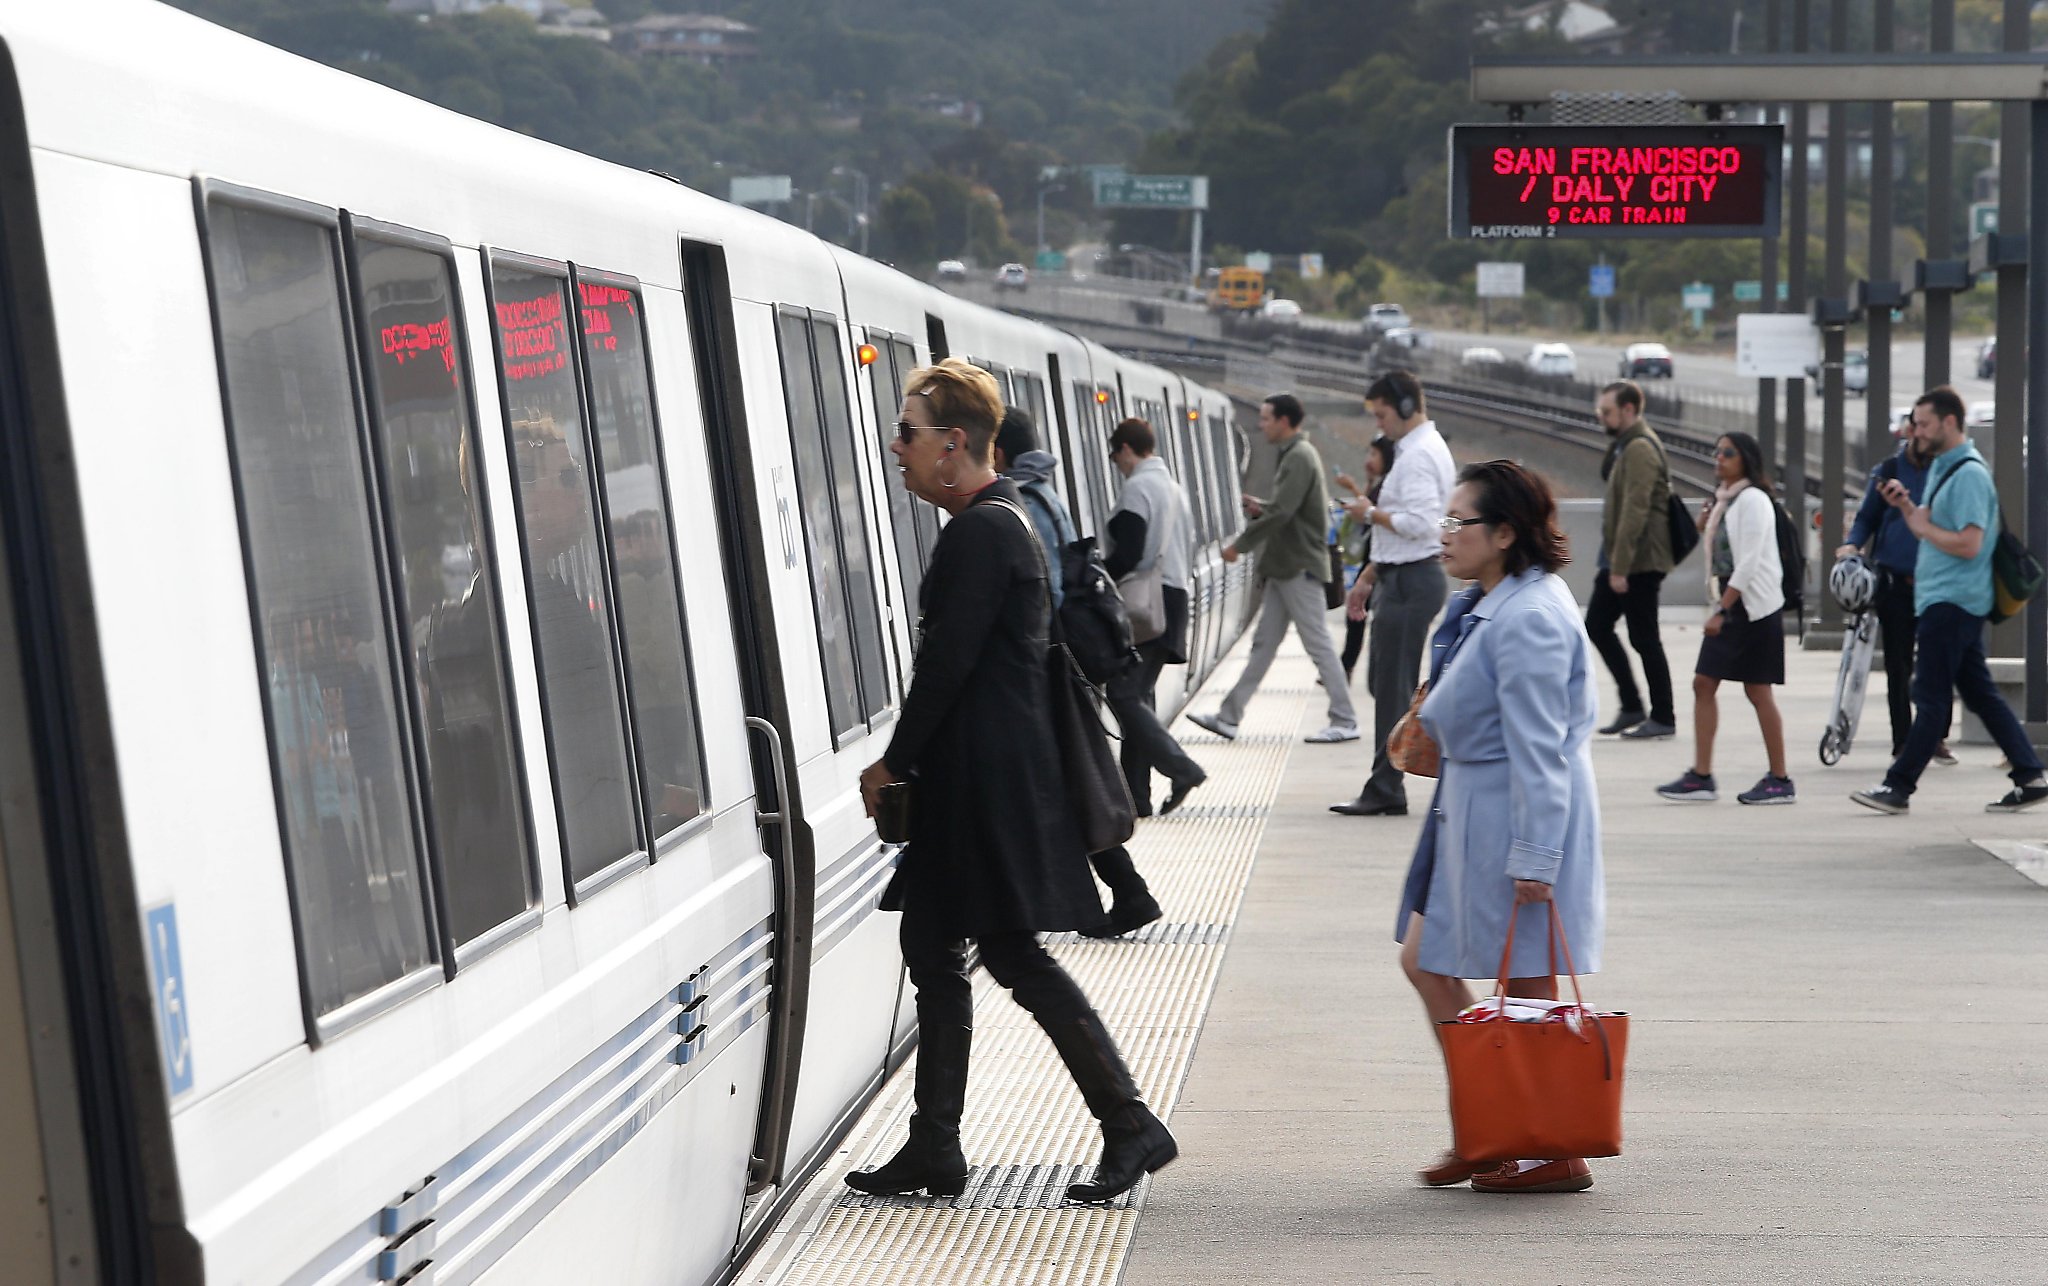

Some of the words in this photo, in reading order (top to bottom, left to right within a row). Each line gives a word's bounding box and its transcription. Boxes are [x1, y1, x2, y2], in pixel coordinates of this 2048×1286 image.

[1493, 147, 1557, 174] SAN
[1571, 147, 1741, 174] FRANCISCO
[1519, 175, 1537, 203] /
[1552, 175, 1635, 203] DALY
[1650, 175, 1718, 203] CITY
[1547, 206, 1560, 224] 9
[1568, 206, 1612, 224] CAR
[1622, 206, 1687, 224] TRAIN
[1471, 225, 1542, 238] PLATFORM
[1546, 225, 1556, 238] 2
